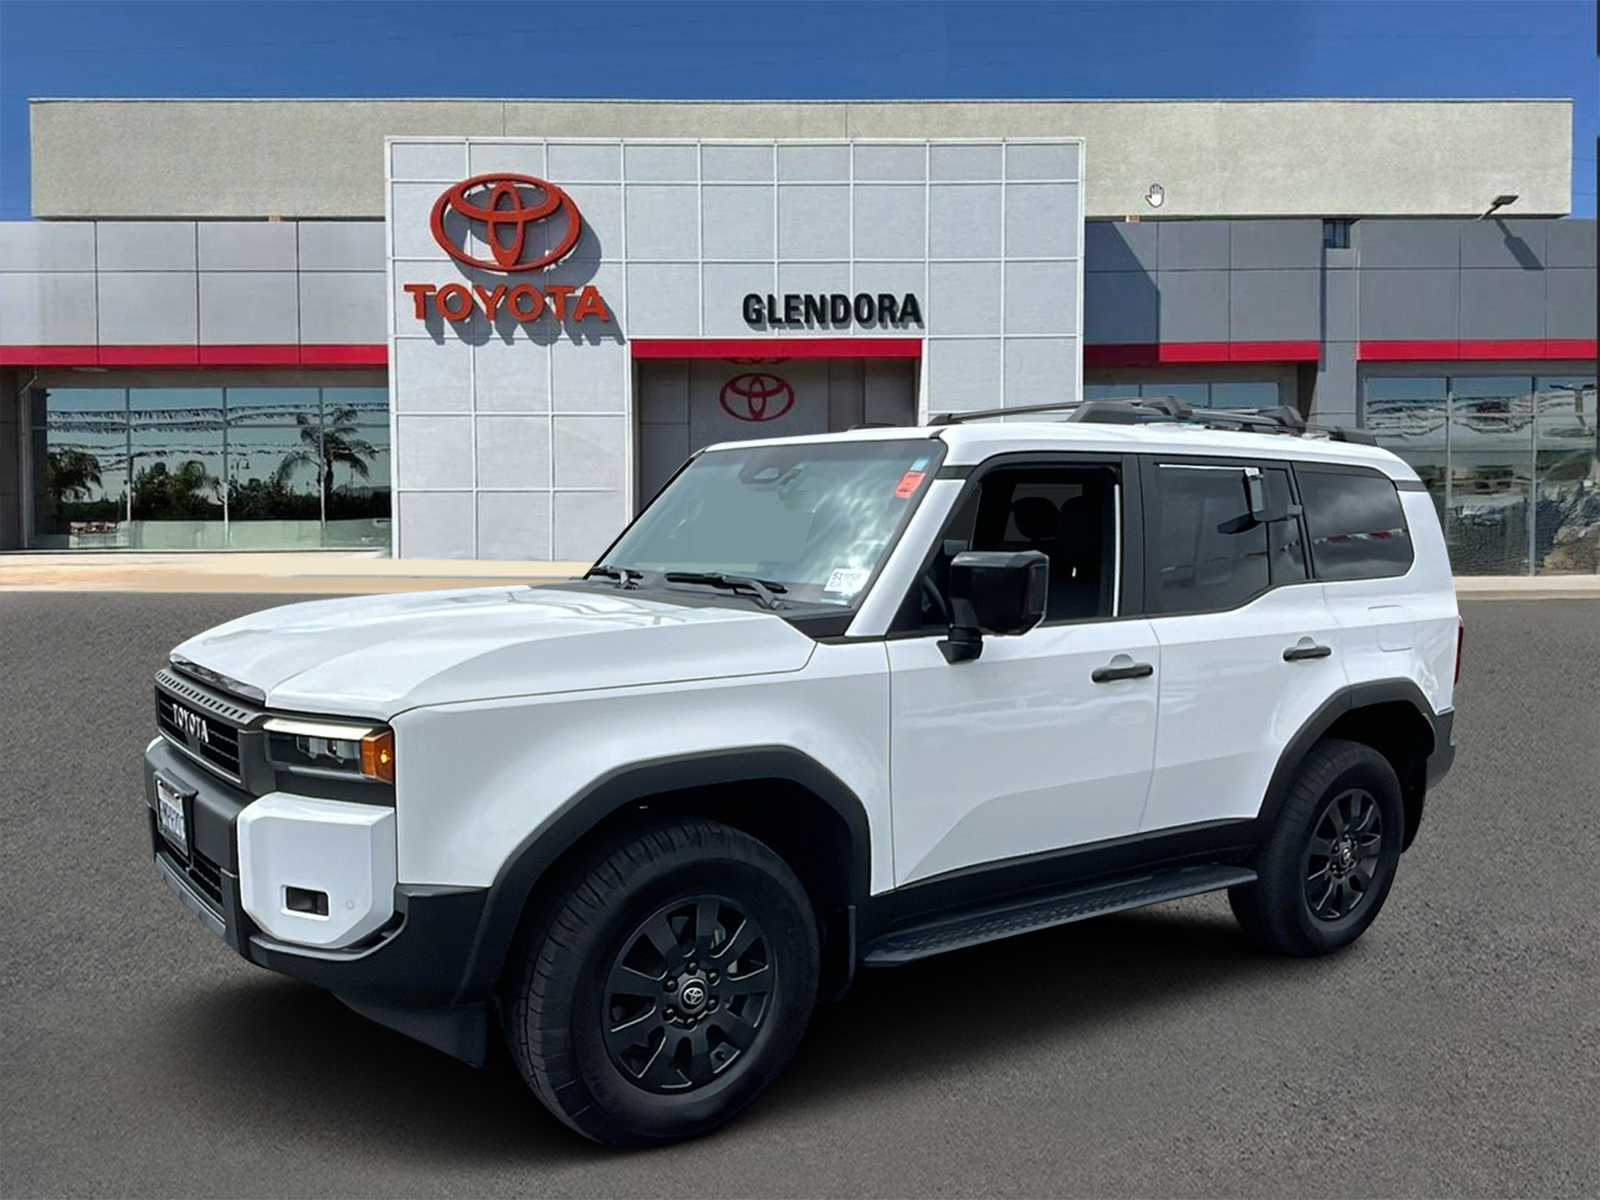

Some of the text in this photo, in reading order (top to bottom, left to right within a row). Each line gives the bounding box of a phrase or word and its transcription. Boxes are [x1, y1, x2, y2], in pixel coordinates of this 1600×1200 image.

[404, 283, 610, 322] TOYOTA
[743, 293, 922, 326] GLENDORA
[172, 703, 209, 743] TOYOTA
